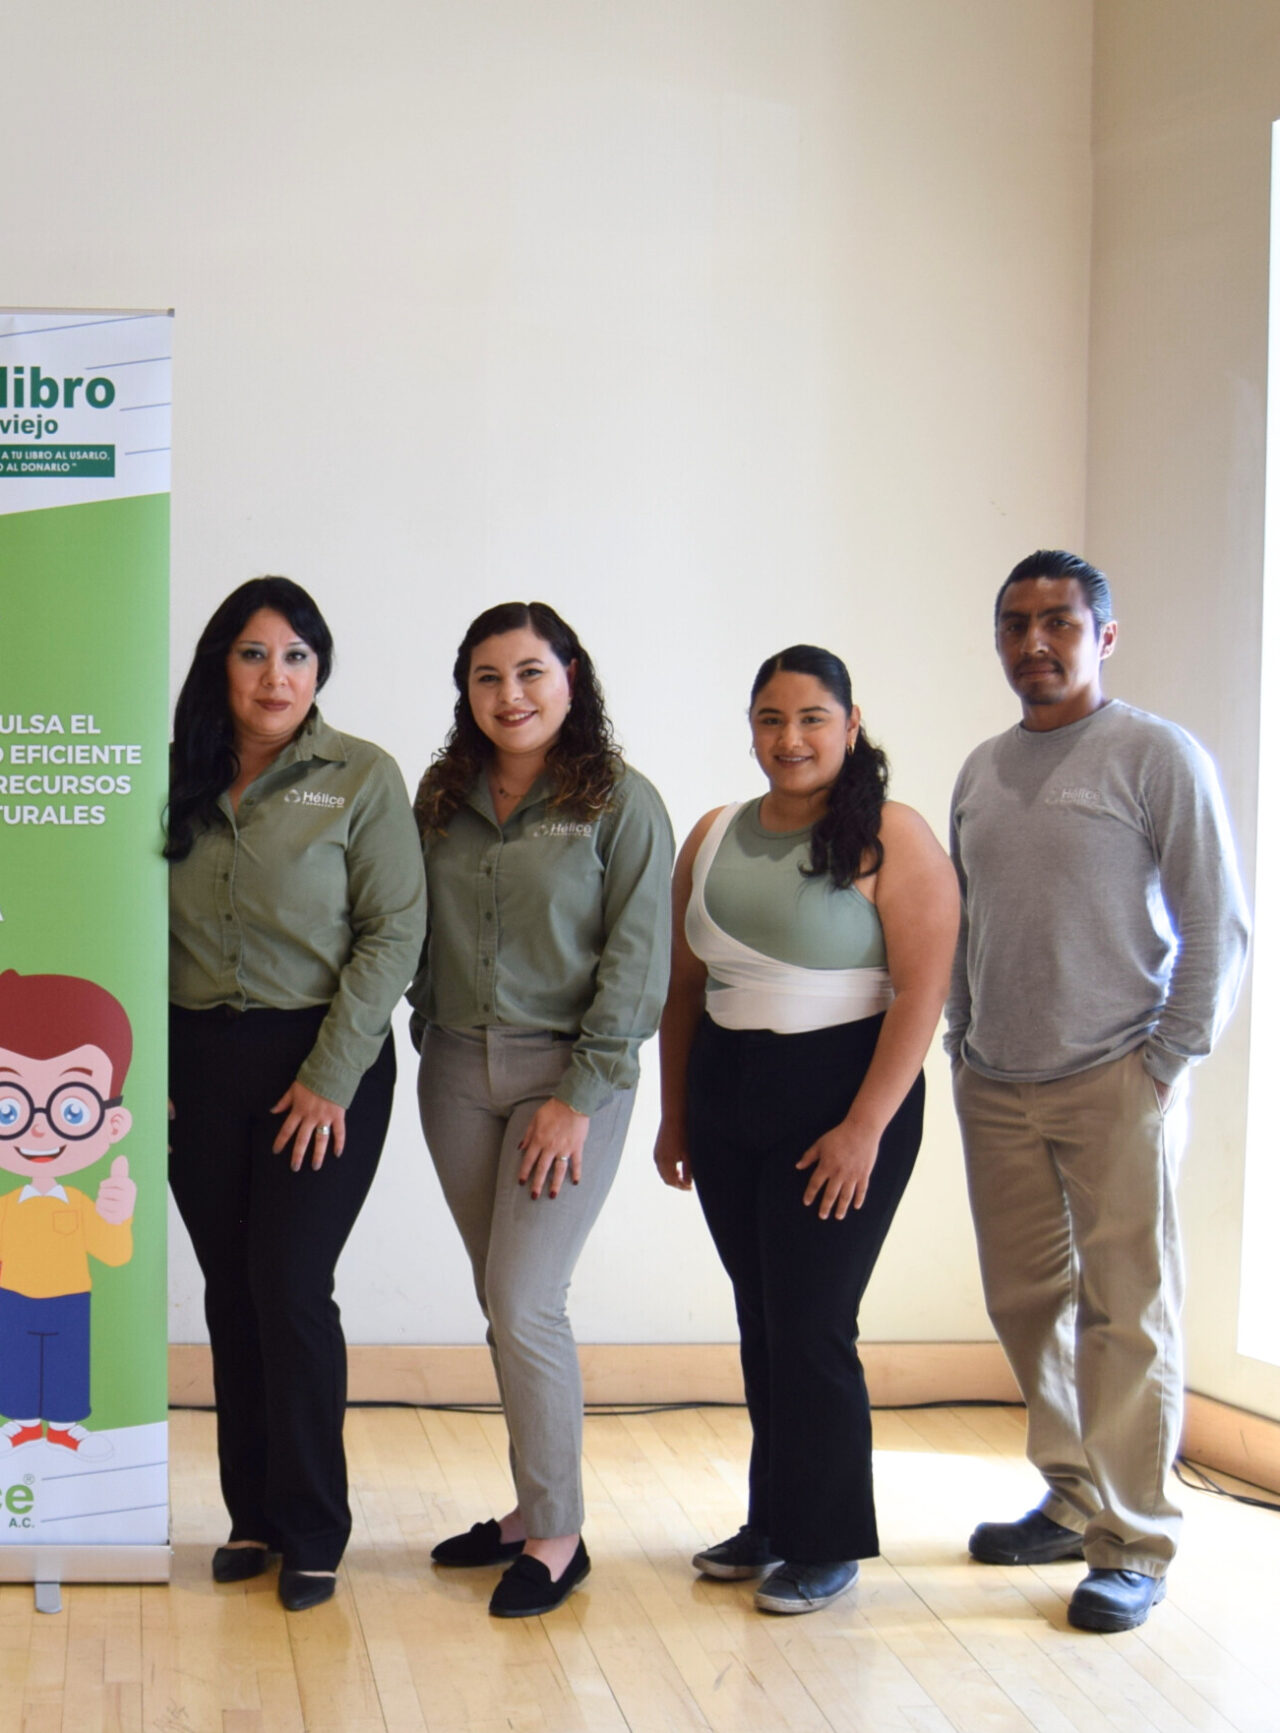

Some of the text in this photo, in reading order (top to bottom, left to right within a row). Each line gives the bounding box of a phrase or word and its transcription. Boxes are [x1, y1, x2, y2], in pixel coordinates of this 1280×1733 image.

[1, 450, 9, 461] A
[11, 450, 22, 461] TU
[25, 450, 53, 461] LIBRO
[55, 450, 68, 461] AL
[69, 450, 111, 462] USARLO,
[6, 463, 19, 473] AL
[21, 463, 70, 473] DONARLO
[71, 714, 100, 734] EL
[11, 744, 142, 765] EFICIENTE
[8, 1517, 35, 1528] A.C.
